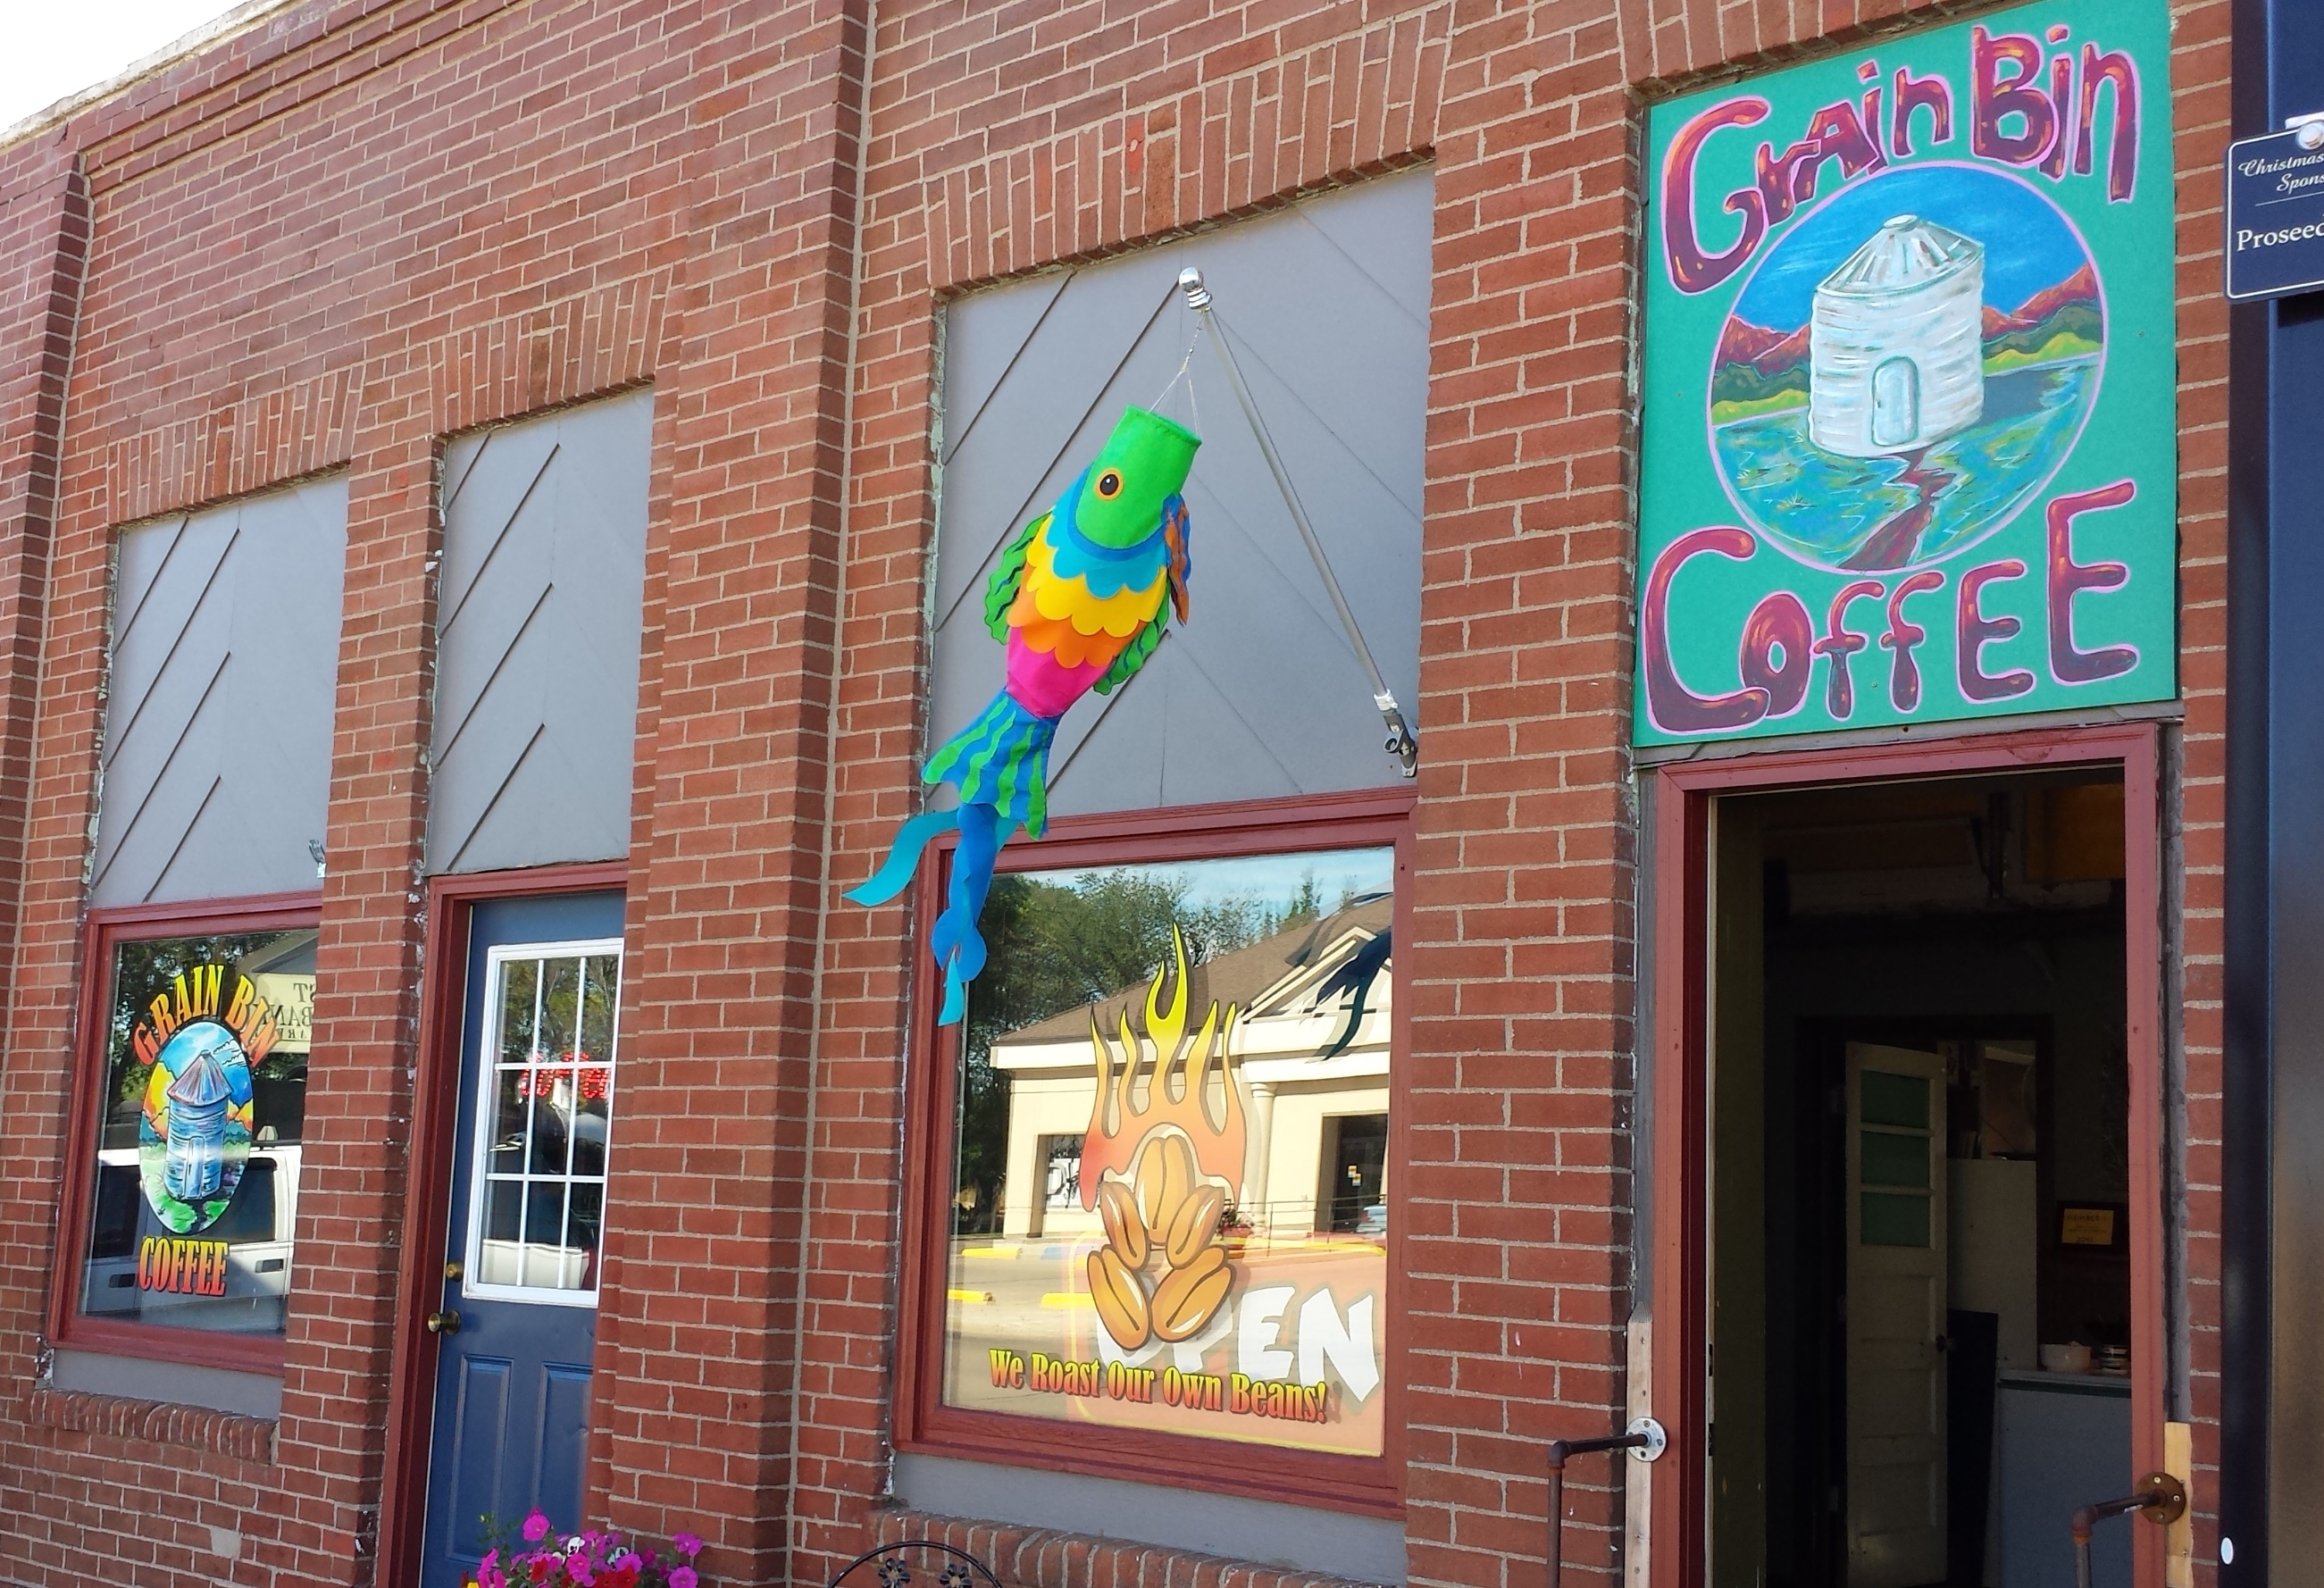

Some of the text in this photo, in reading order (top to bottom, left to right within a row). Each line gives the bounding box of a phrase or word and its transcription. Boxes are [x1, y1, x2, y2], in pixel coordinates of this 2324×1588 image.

[1971, 23, 2141, 204] Bin
[2237, 153, 2324, 177] Christmas
[133, 963, 281, 1068] GRAIN BIN
[138, 1236, 230, 1297] COFFEE
[989, 1349, 1328, 1424] We Roast Our Own Beans!
